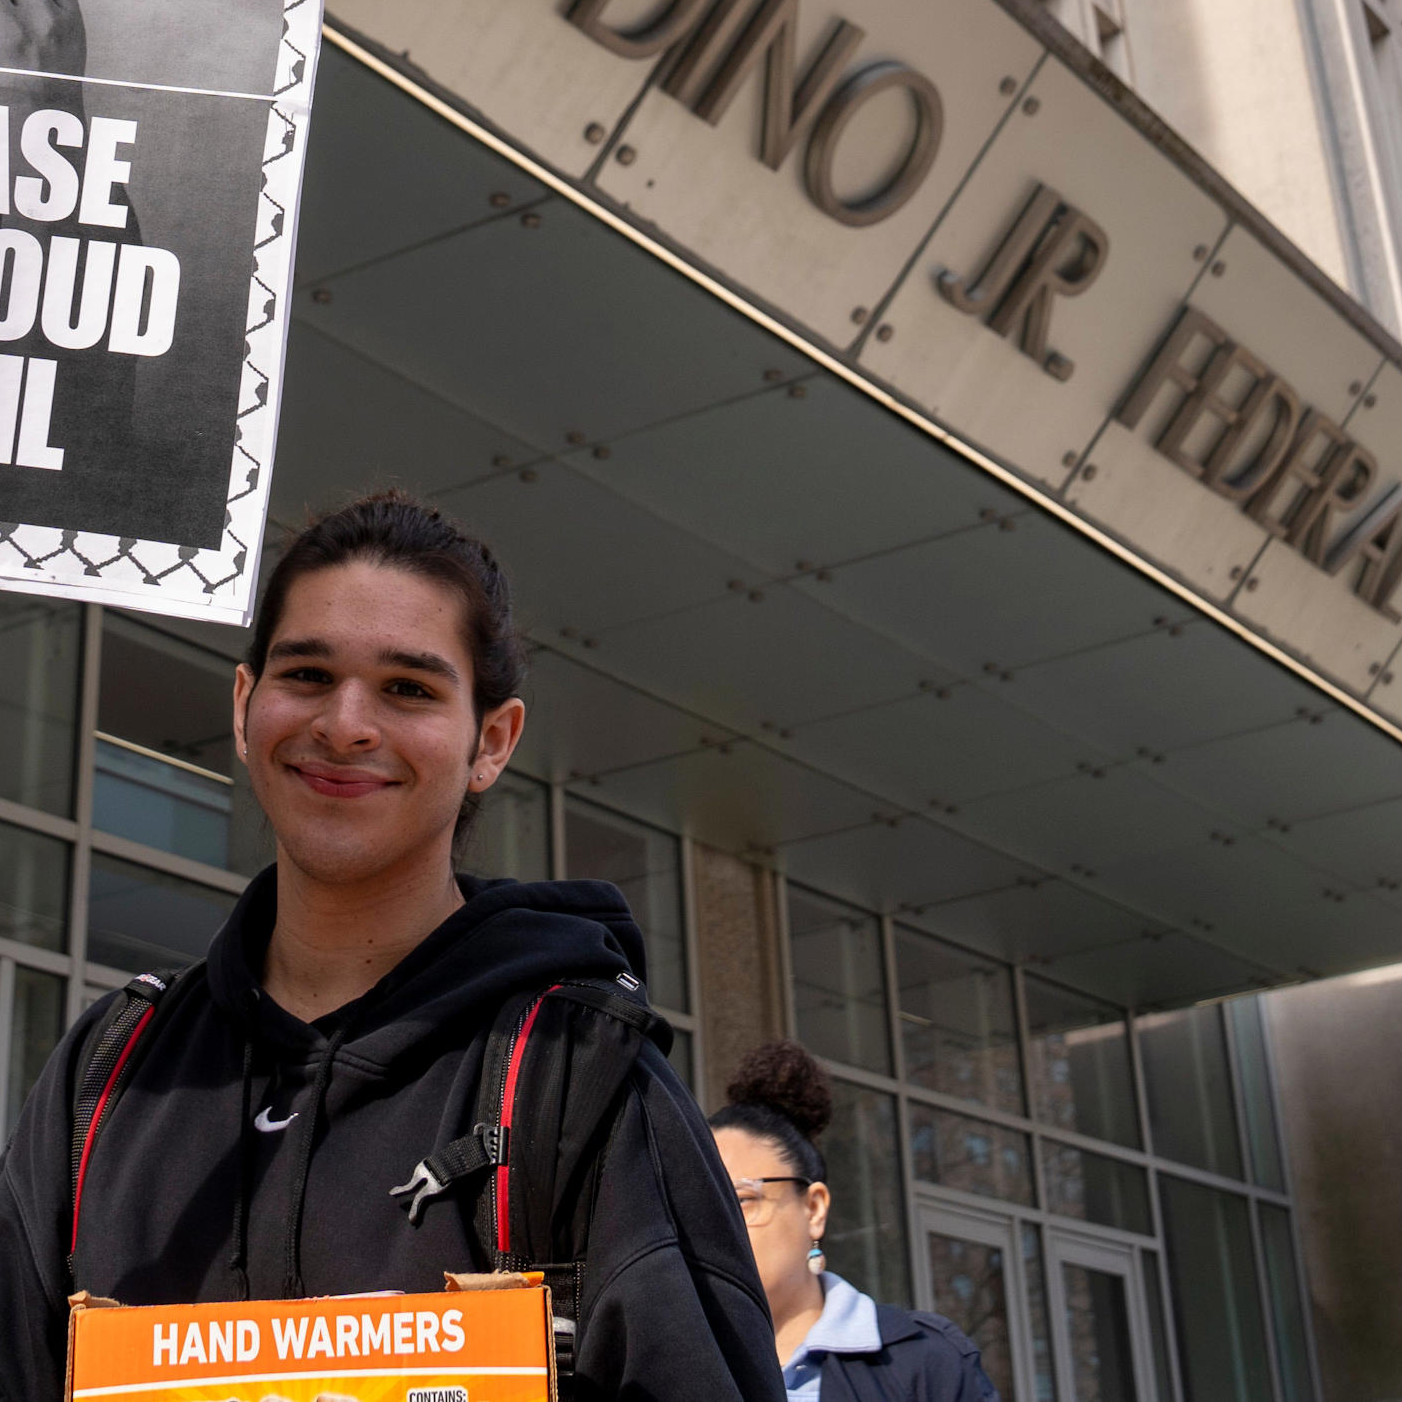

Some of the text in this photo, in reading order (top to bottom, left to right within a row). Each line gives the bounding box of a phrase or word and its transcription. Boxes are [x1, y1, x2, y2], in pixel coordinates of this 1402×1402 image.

[153, 1309, 466, 1366] HAND WARMERS
[410, 1390, 466, 1402] CONTAINS:
